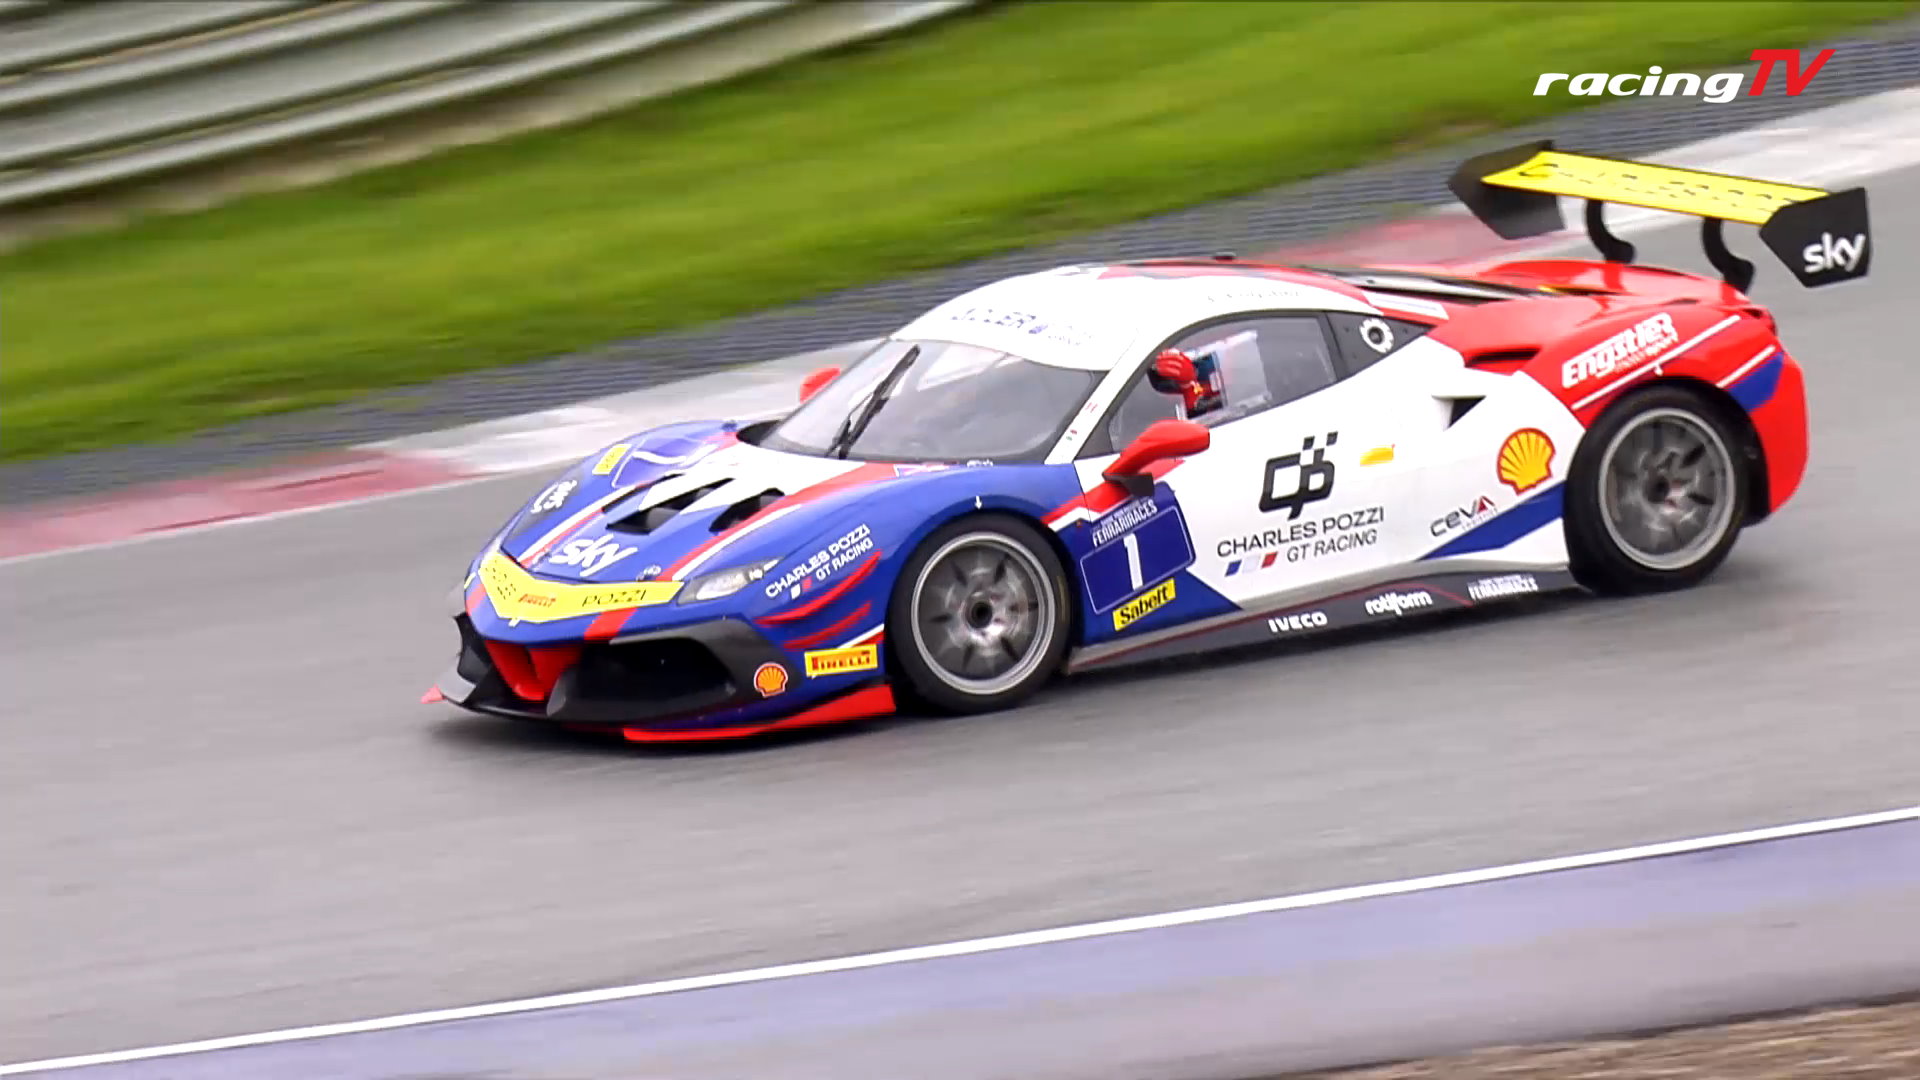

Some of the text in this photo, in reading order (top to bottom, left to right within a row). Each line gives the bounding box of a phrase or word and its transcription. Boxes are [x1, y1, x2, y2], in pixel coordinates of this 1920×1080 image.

[1803, 232, 1866, 274] sky
[1217, 506, 1385, 557] CHARLES POZZI
[1286, 529, 1378, 563] GT RACING
[549, 534, 639, 577] sky
[765, 523, 871, 598] CHARLES POZZI
[816, 537, 874, 581] GT RACING
[1123, 533, 1144, 592] 1
[582, 589, 647, 608] POZZI
[1119, 585, 1169, 625] Sabelt
[1268, 611, 1328, 633] IVECO
[811, 650, 871, 671] PIRELLI
